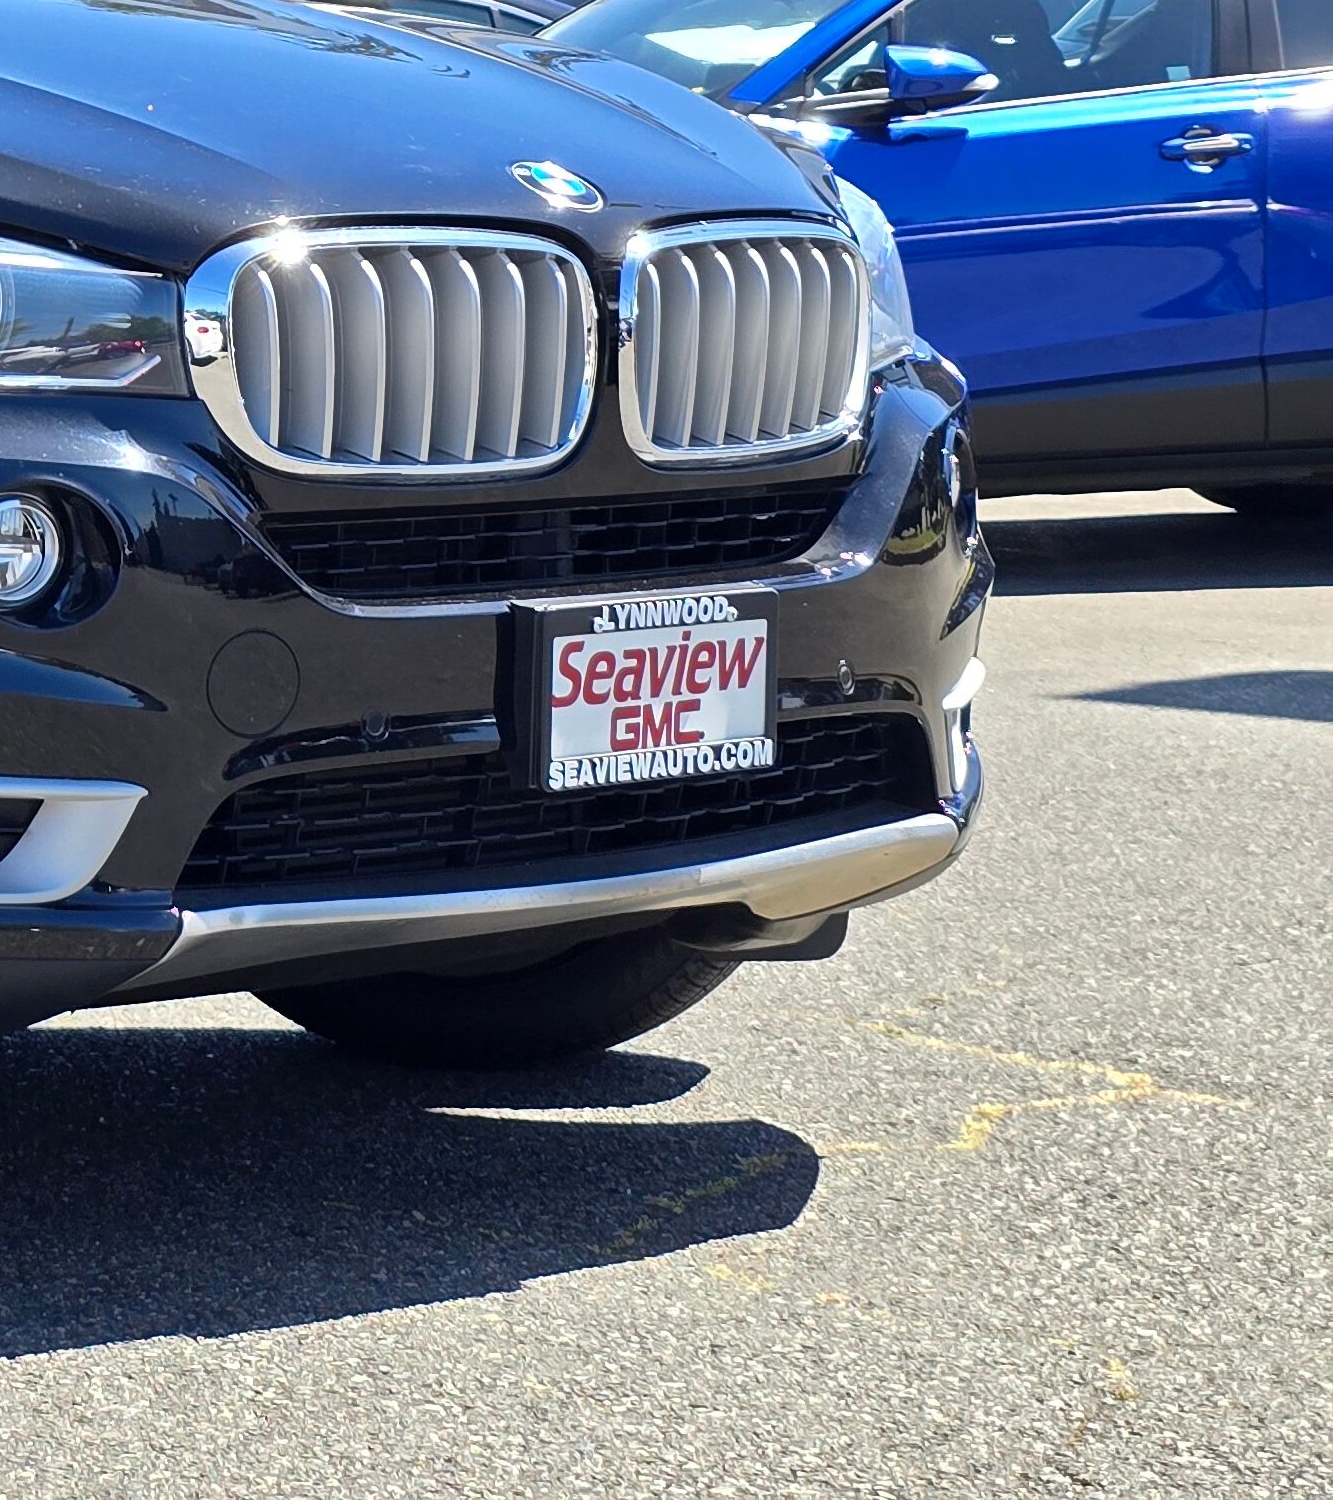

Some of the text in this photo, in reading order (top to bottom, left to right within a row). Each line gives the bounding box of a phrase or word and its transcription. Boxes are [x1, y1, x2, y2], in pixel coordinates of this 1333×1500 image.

[600, 595, 730, 632] LYNNWOOD
[551, 630, 766, 708] Seaview
[609, 698, 706, 753] GMC
[548, 738, 774, 790] SEAVIEWAUTO.COM
